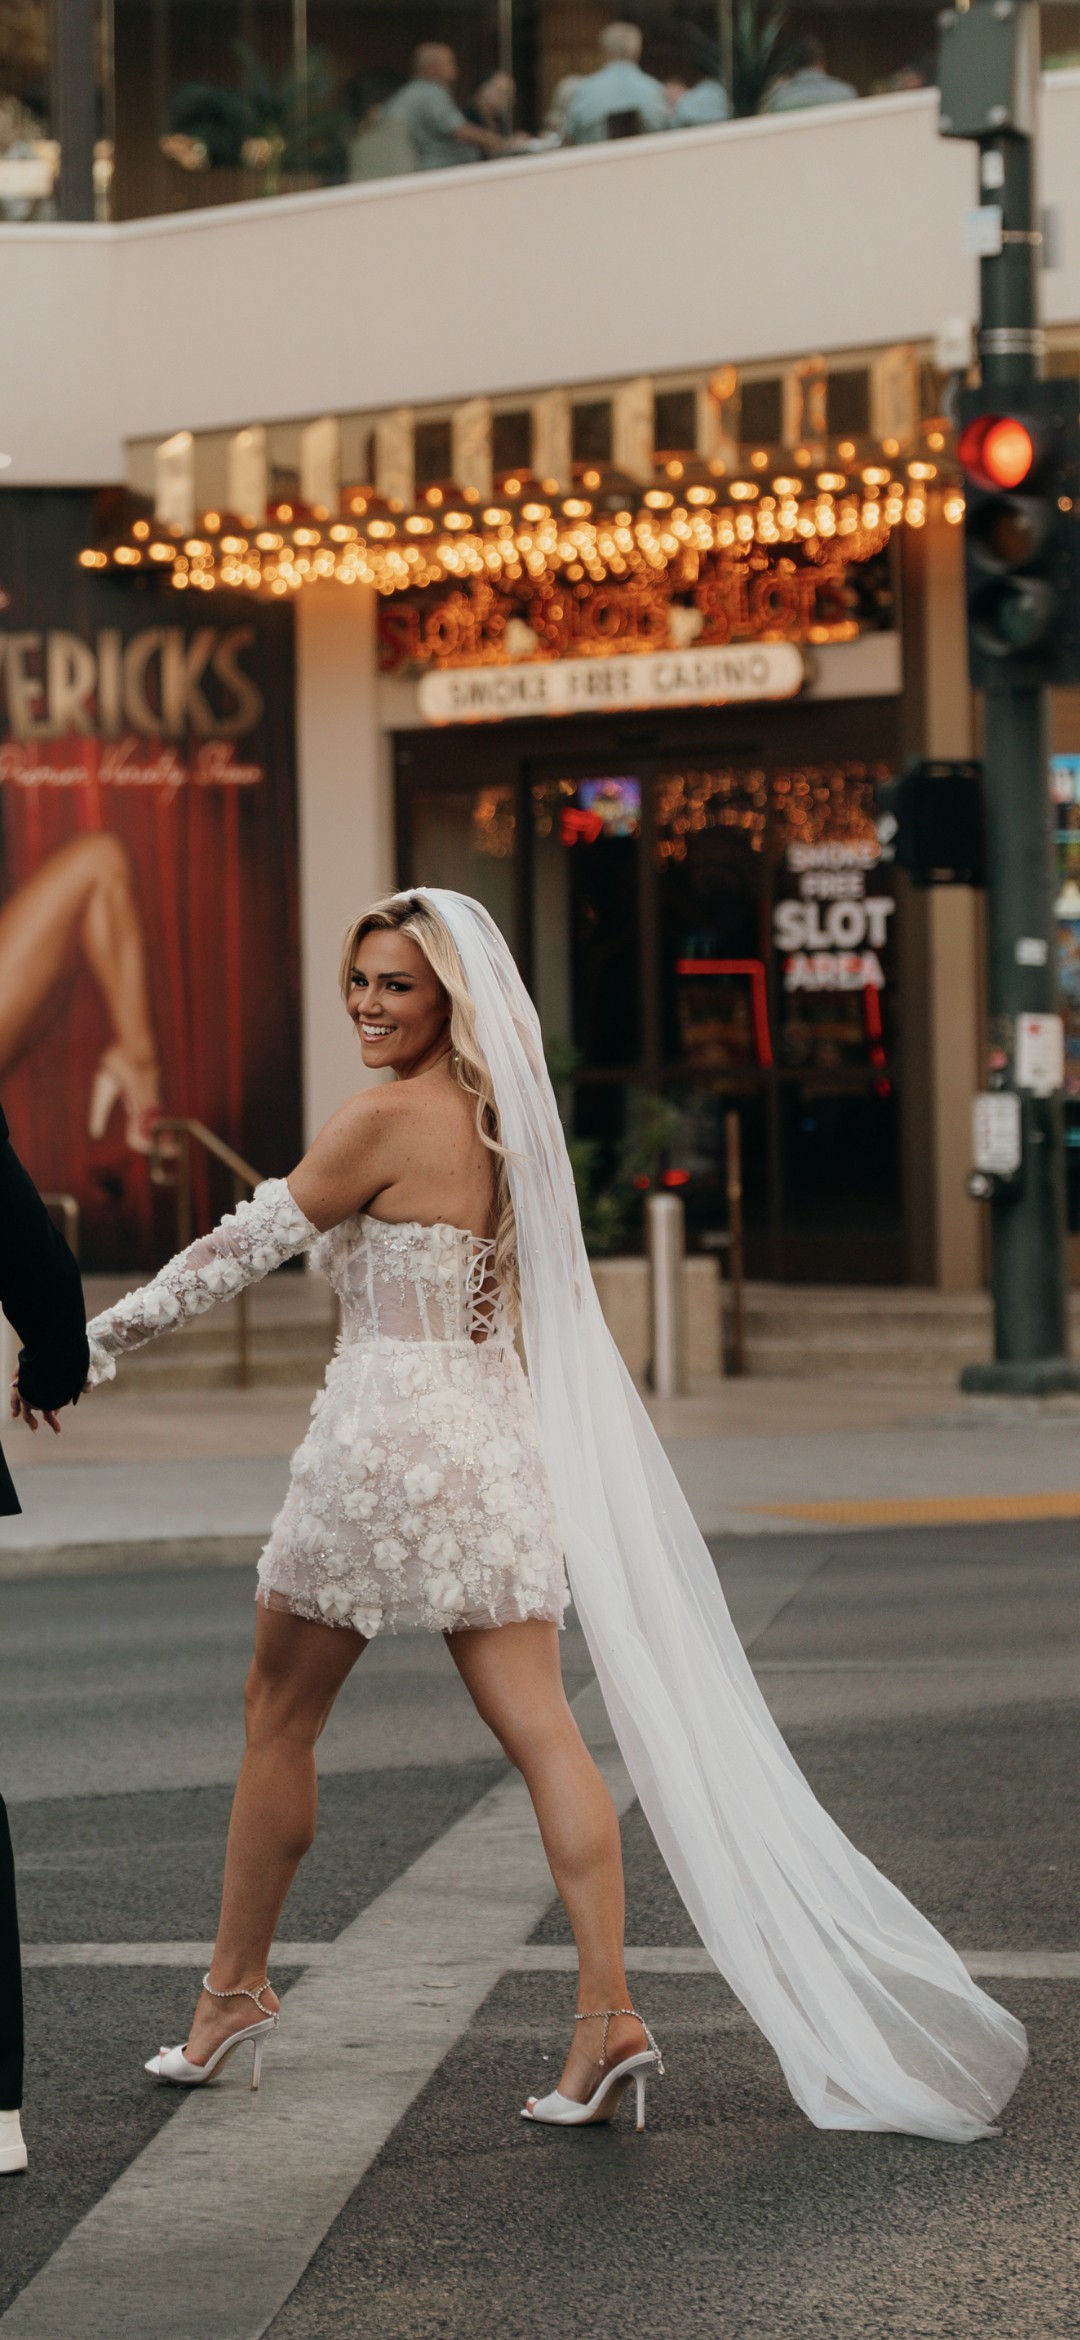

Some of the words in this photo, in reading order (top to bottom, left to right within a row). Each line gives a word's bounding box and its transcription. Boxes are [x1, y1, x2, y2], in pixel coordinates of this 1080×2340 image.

[448, 670, 548, 707] SMOKE
[566, 664, 633, 698] FREE
[650, 653, 771, 694] CASINO
[786, 841, 882, 872] SMOKE
[801, 870, 866, 899] FREE
[774, 896, 896, 950] SLOT
[783, 951, 886, 992] AREA
